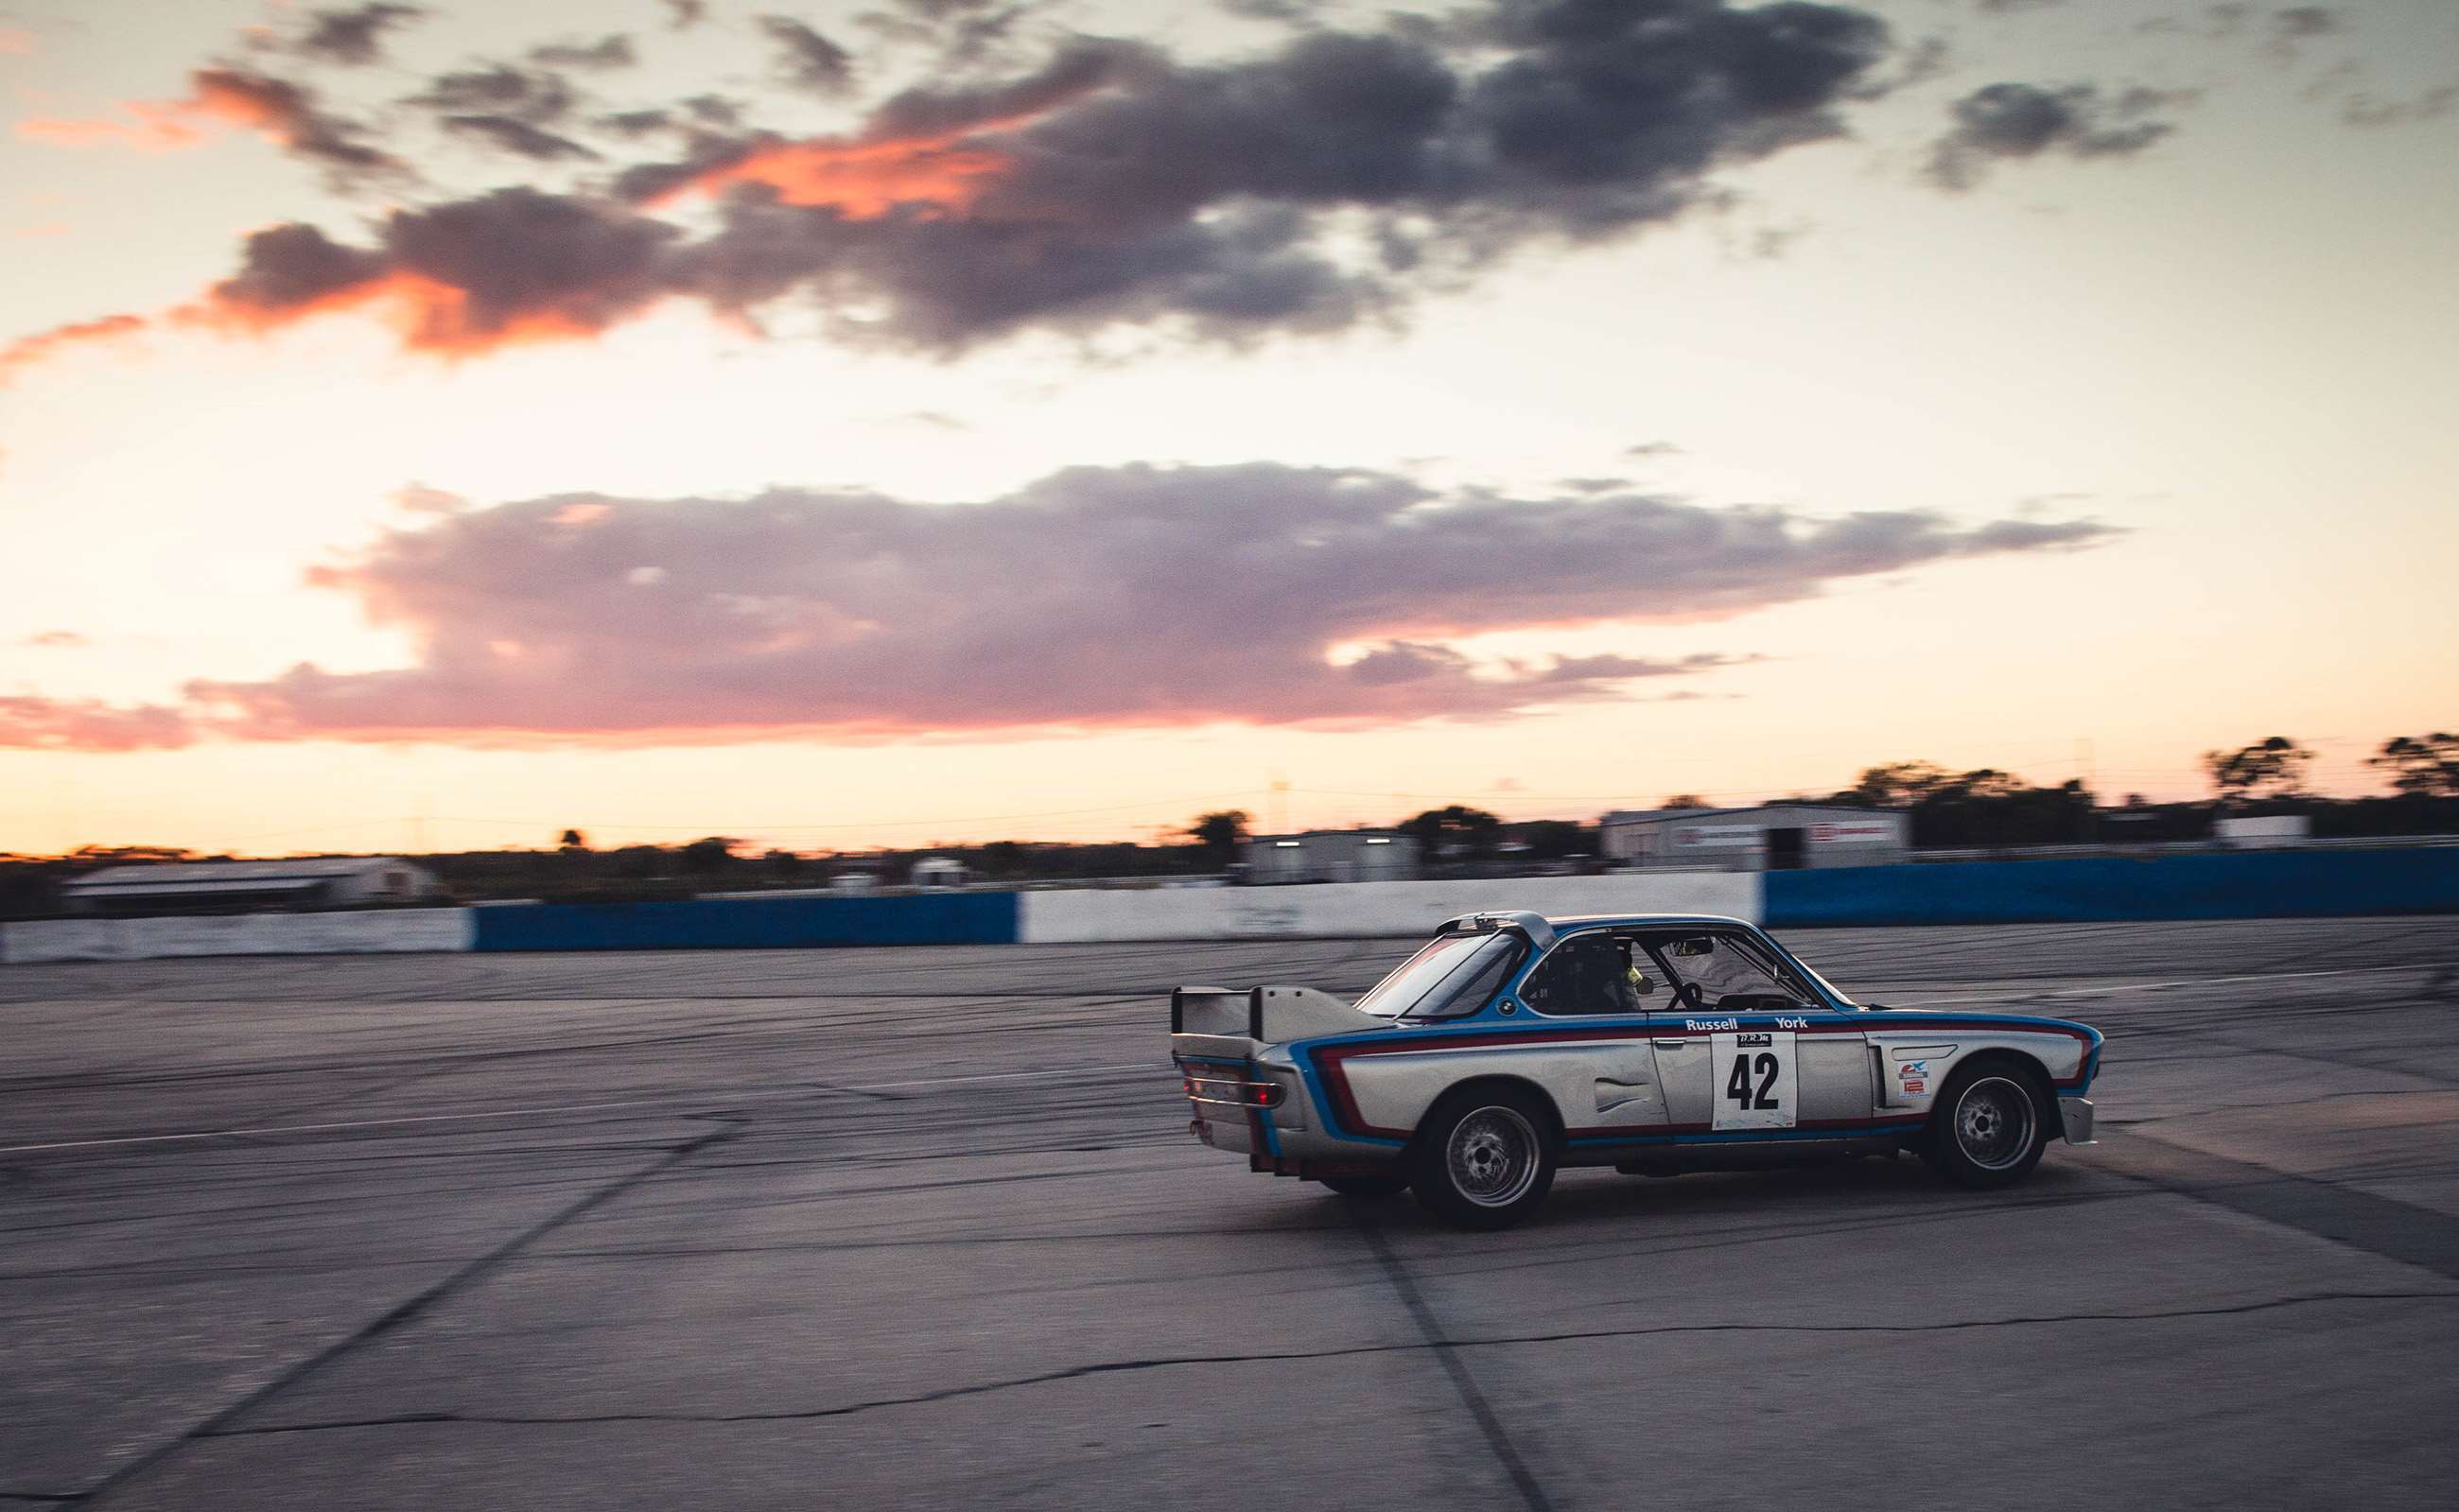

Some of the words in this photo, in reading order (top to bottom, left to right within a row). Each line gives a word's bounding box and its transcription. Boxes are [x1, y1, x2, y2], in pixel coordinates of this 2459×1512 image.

[1685, 1017, 1738, 1031] Russell
[1775, 1017, 1808, 1029] York
[1727, 1052, 1779, 1110] 42
